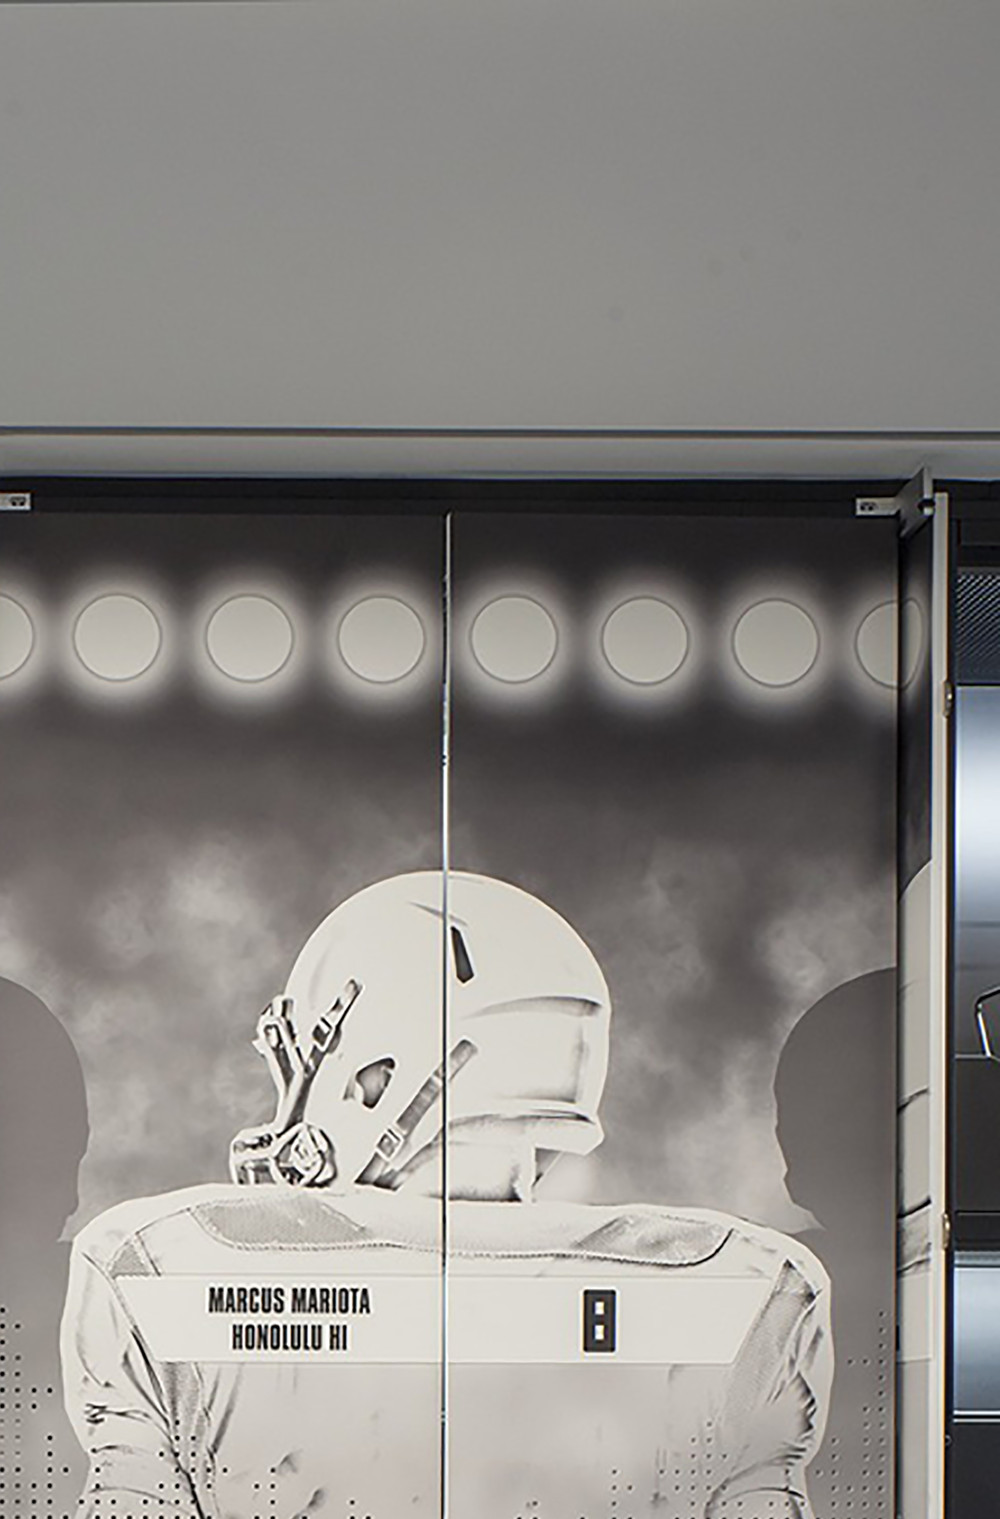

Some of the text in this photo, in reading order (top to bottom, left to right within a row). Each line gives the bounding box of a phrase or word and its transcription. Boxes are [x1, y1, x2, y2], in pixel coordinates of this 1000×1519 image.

[208, 1286, 371, 1315] MARCUS MARIOTA
[582, 1289, 617, 1353] 8
[232, 1323, 348, 1351] HONOLULU HI
